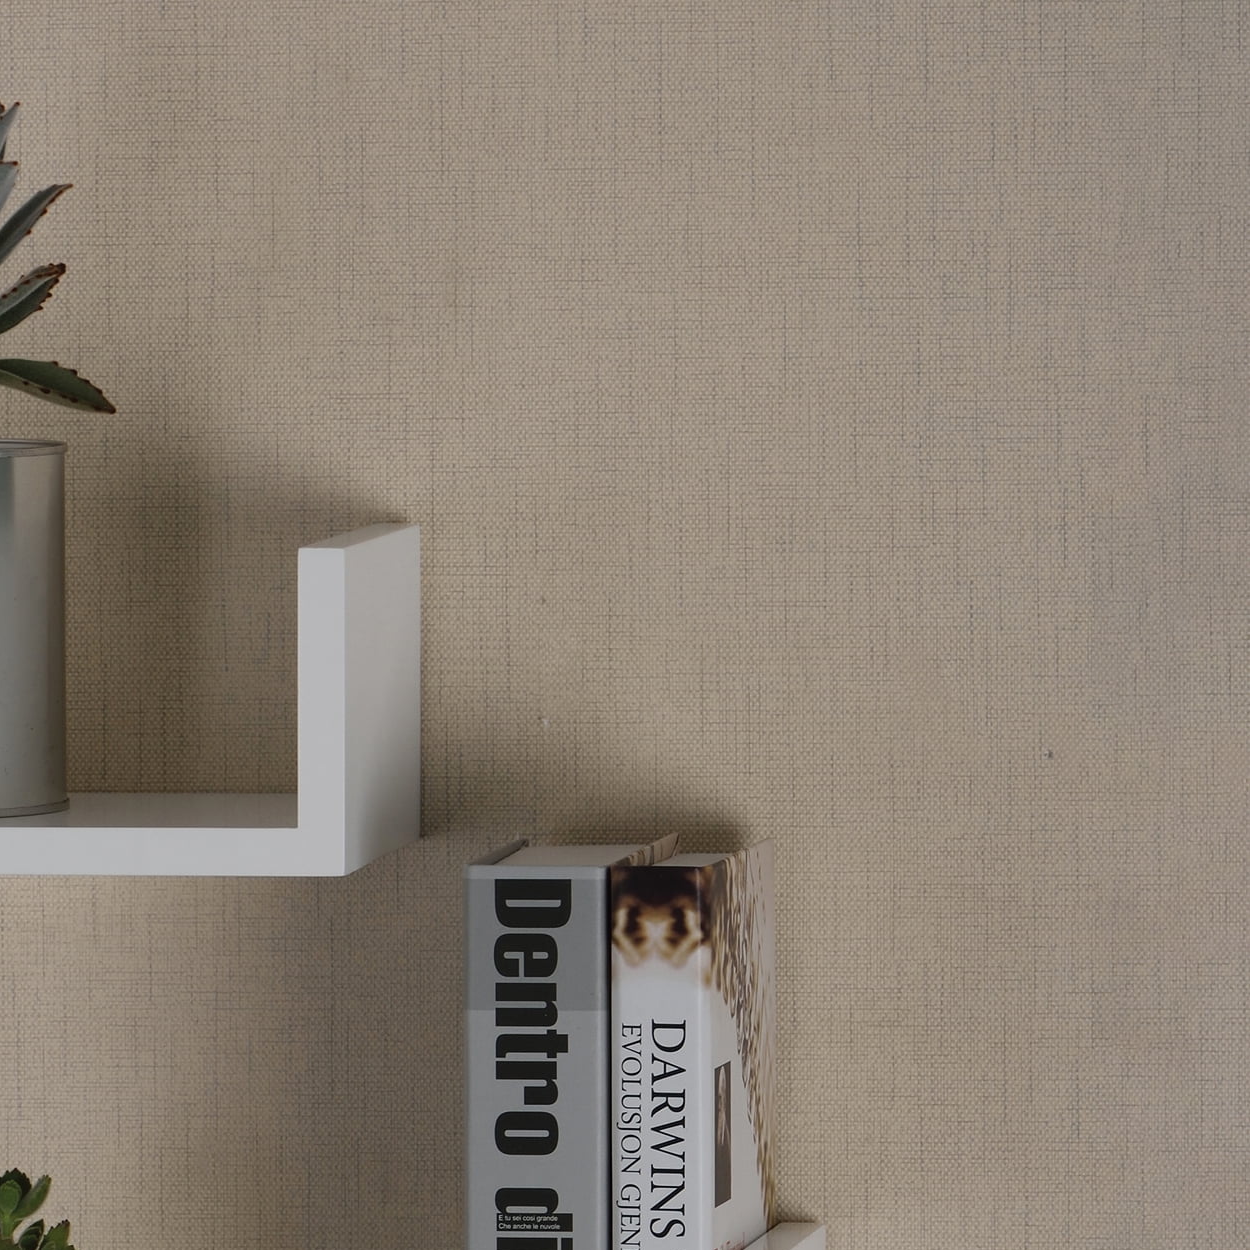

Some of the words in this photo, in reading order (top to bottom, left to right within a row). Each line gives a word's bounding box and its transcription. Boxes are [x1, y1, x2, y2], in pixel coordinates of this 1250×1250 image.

[494, 878, 572, 1155] Dentro
[616, 1022, 643, 1175] EVOLUSJON
[650, 1018, 687, 1239] DARWINS
[498, 1222, 511, 1230] Che
[536, 1215, 558, 1223] grande
